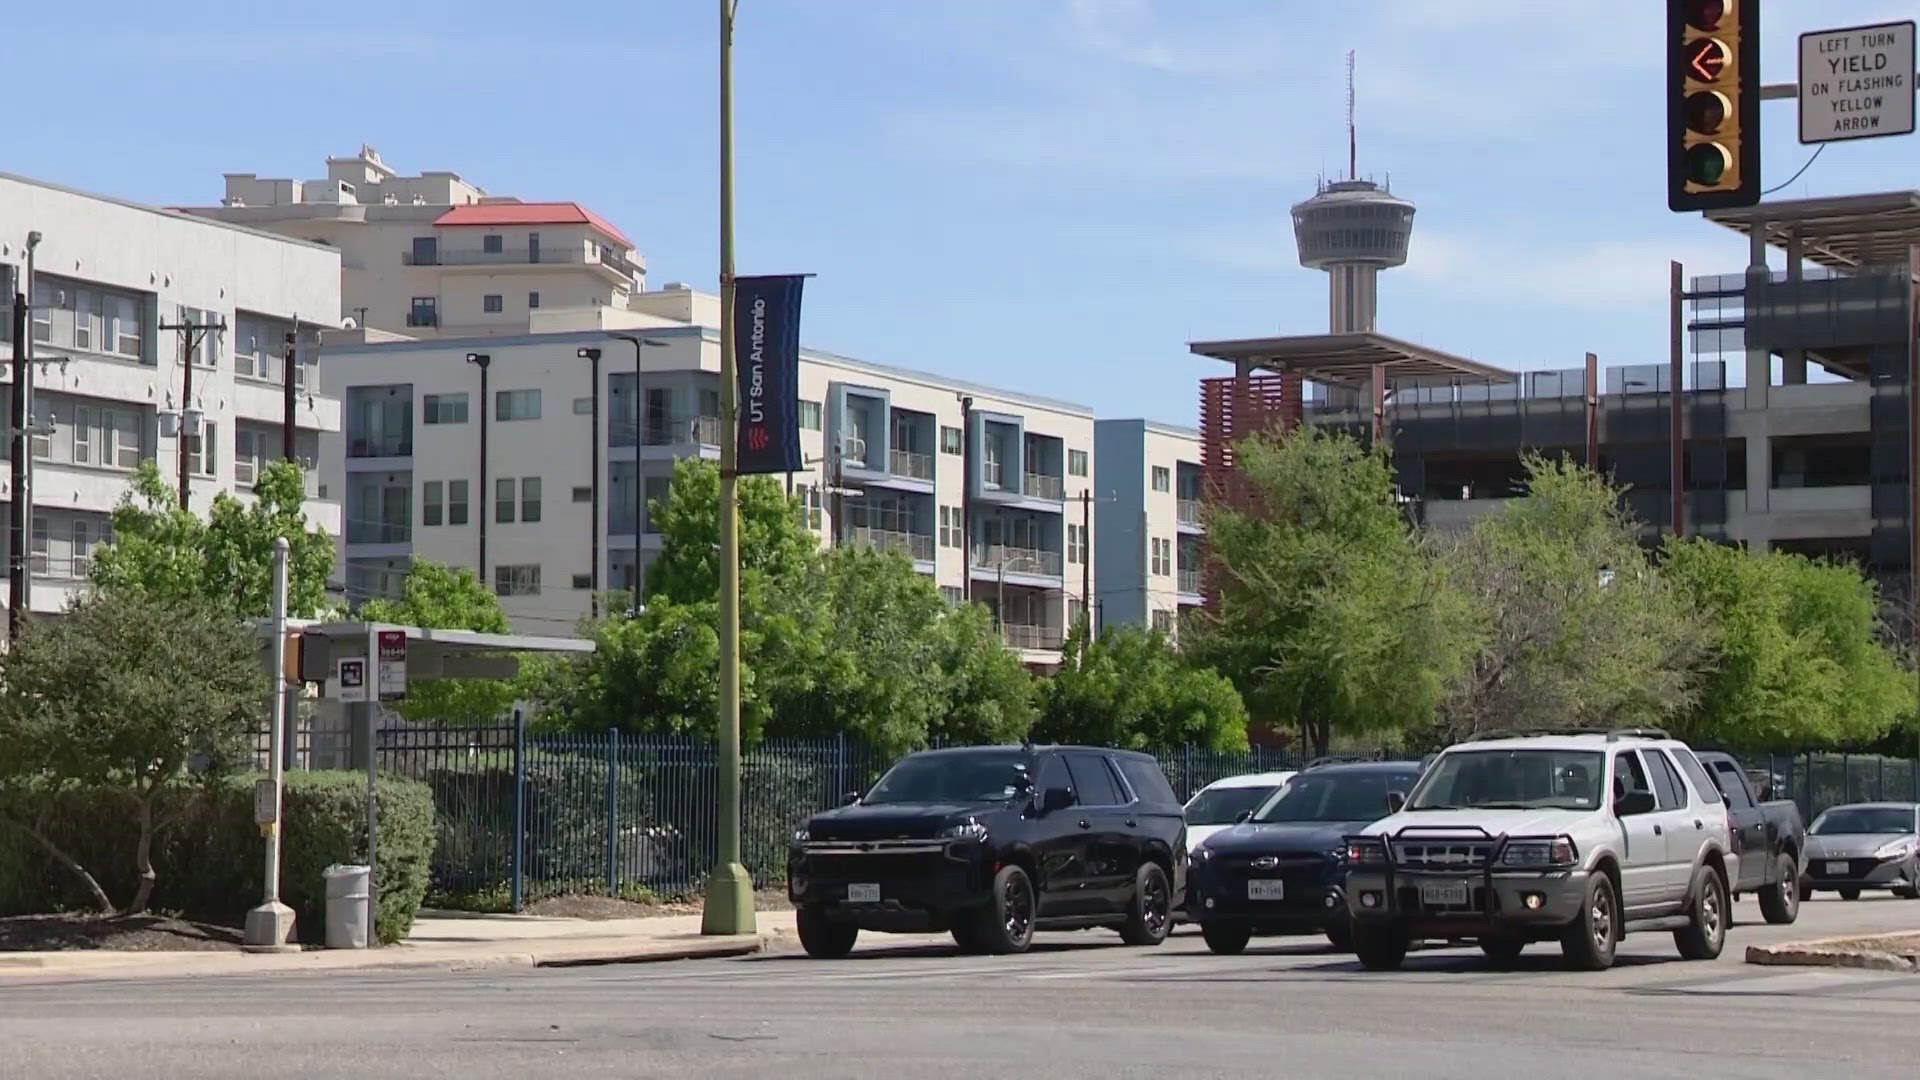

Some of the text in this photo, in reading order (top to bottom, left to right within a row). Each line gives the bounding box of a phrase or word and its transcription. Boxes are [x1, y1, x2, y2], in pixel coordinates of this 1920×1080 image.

[1819, 33, 1895, 54] LEFT TURN
[1828, 53, 1887, 74] YIELD
[1811, 75, 1903, 96] ON FLASHING
[1831, 96, 1883, 112] YELLOW
[1834, 115, 1880, 132] ARROW
[750, 298, 766, 422] UT San Antonio
